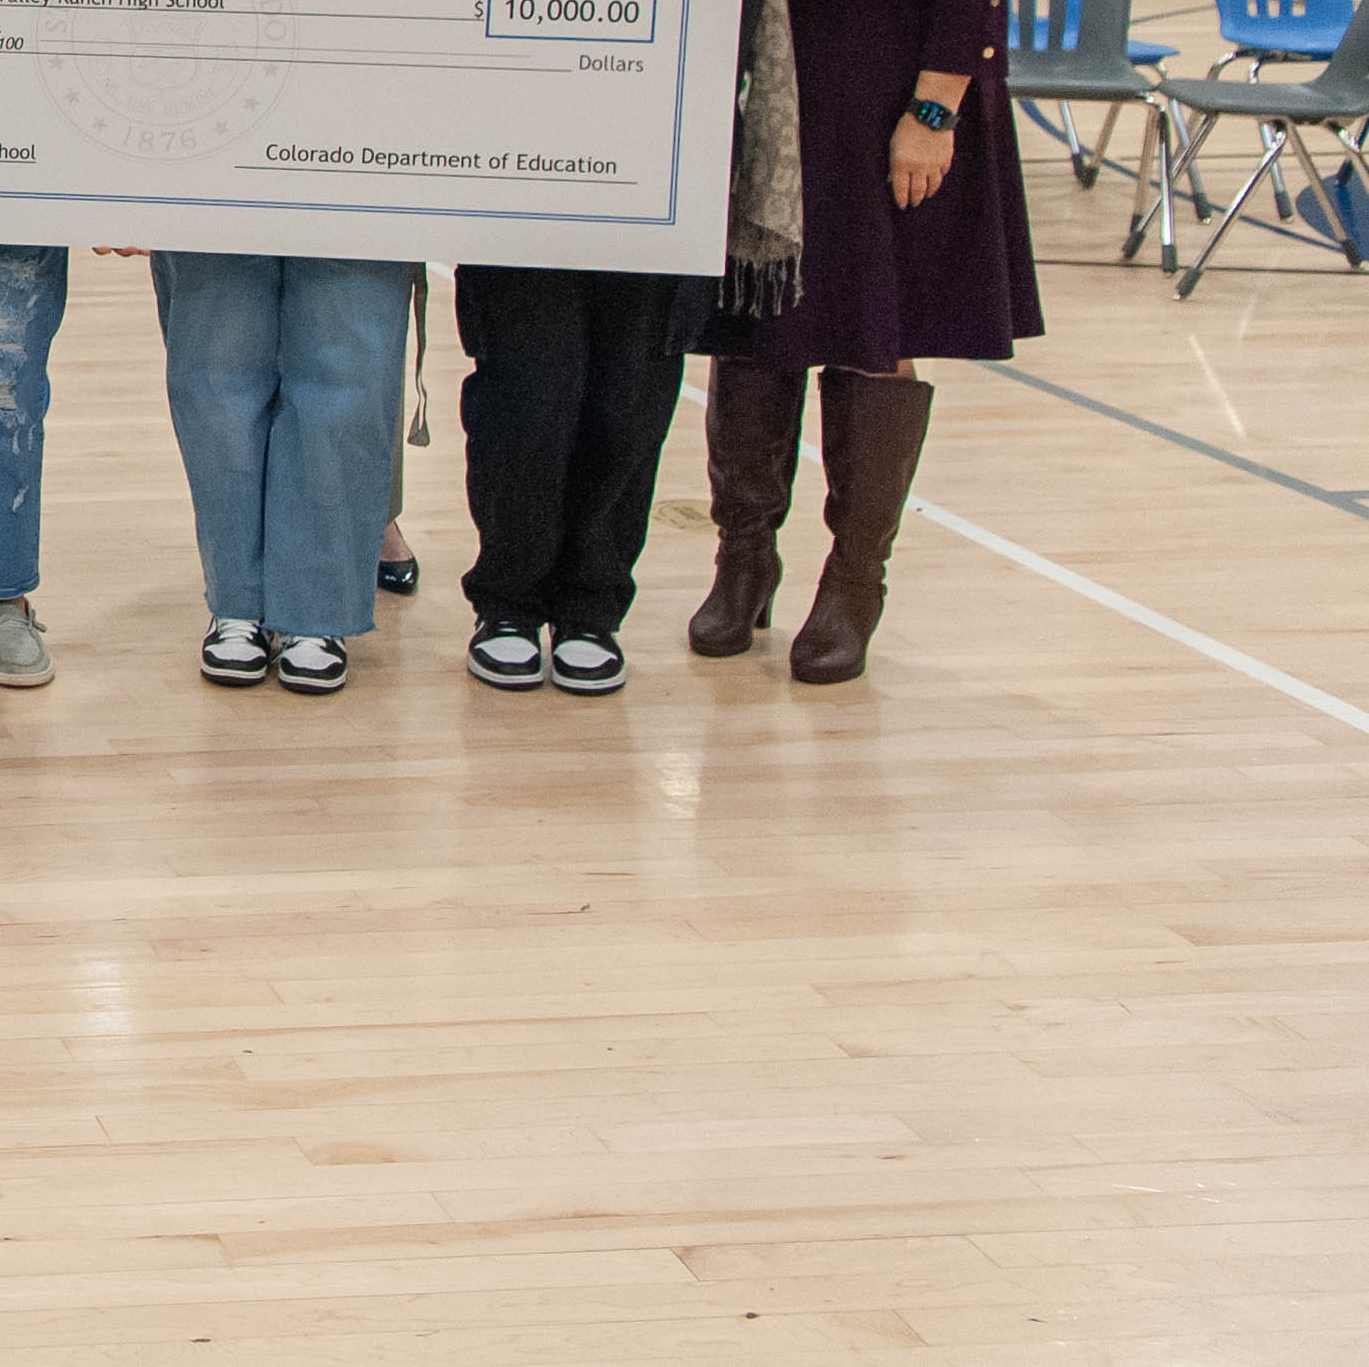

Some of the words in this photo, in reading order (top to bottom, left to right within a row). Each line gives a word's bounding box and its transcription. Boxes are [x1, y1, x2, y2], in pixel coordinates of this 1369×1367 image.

[473, 0, 484, 20] $
[578, 54, 645, 73] Dollars
[121, 125, 197, 152] 1876
[265, 144, 355, 164] Colorado
[361, 147, 481, 170] Department
[488, 152, 509, 170] of
[516, 153, 617, 174] Education
